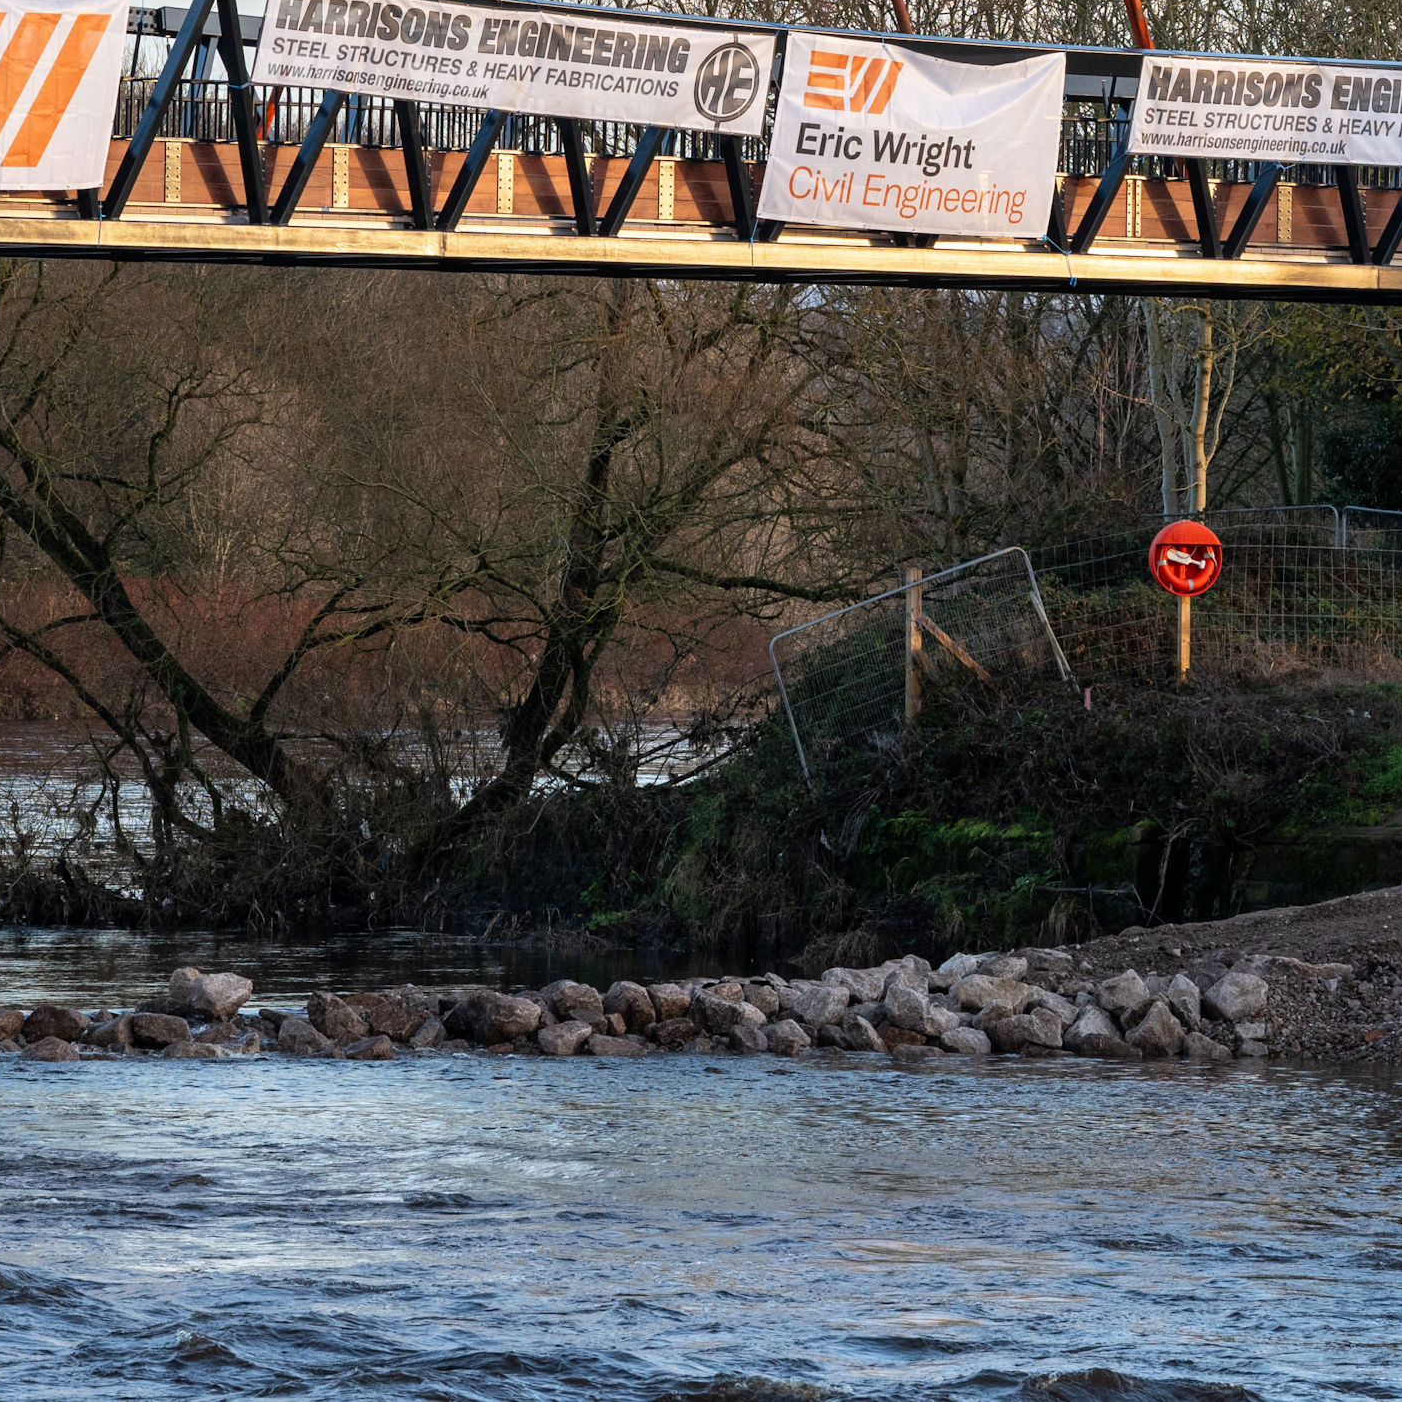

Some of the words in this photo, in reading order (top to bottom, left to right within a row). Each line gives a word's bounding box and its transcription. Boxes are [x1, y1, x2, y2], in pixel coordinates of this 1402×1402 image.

[272, 37, 330, 60] STEEL
[336, 44, 462, 76] STRUCTURES
[466, 60, 478, 78] &
[484, 62, 540, 84] HEAVY
[545, 68, 679, 98] FABRICATIONS
[479, 18, 691, 74] ENGINEERING
[267, 61, 489, 101] www.harrisonsengineering.co.uk
[1146, 65, 1322, 108] HARRISONS
[1140, 130, 1347, 156] www.harrisonsengineering.co.uk
[1144, 107, 1199, 127] STEEL
[1203, 112, 1317, 134] STRUCTURES
[1322, 117, 1333, 133] &
[1338, 117, 1395, 138] HEAVY
[795, 122, 862, 160] Eric
[874, 129, 976, 177] Wright
[788, 165, 854, 204] Civil
[862, 173, 1027, 224] Engineering
